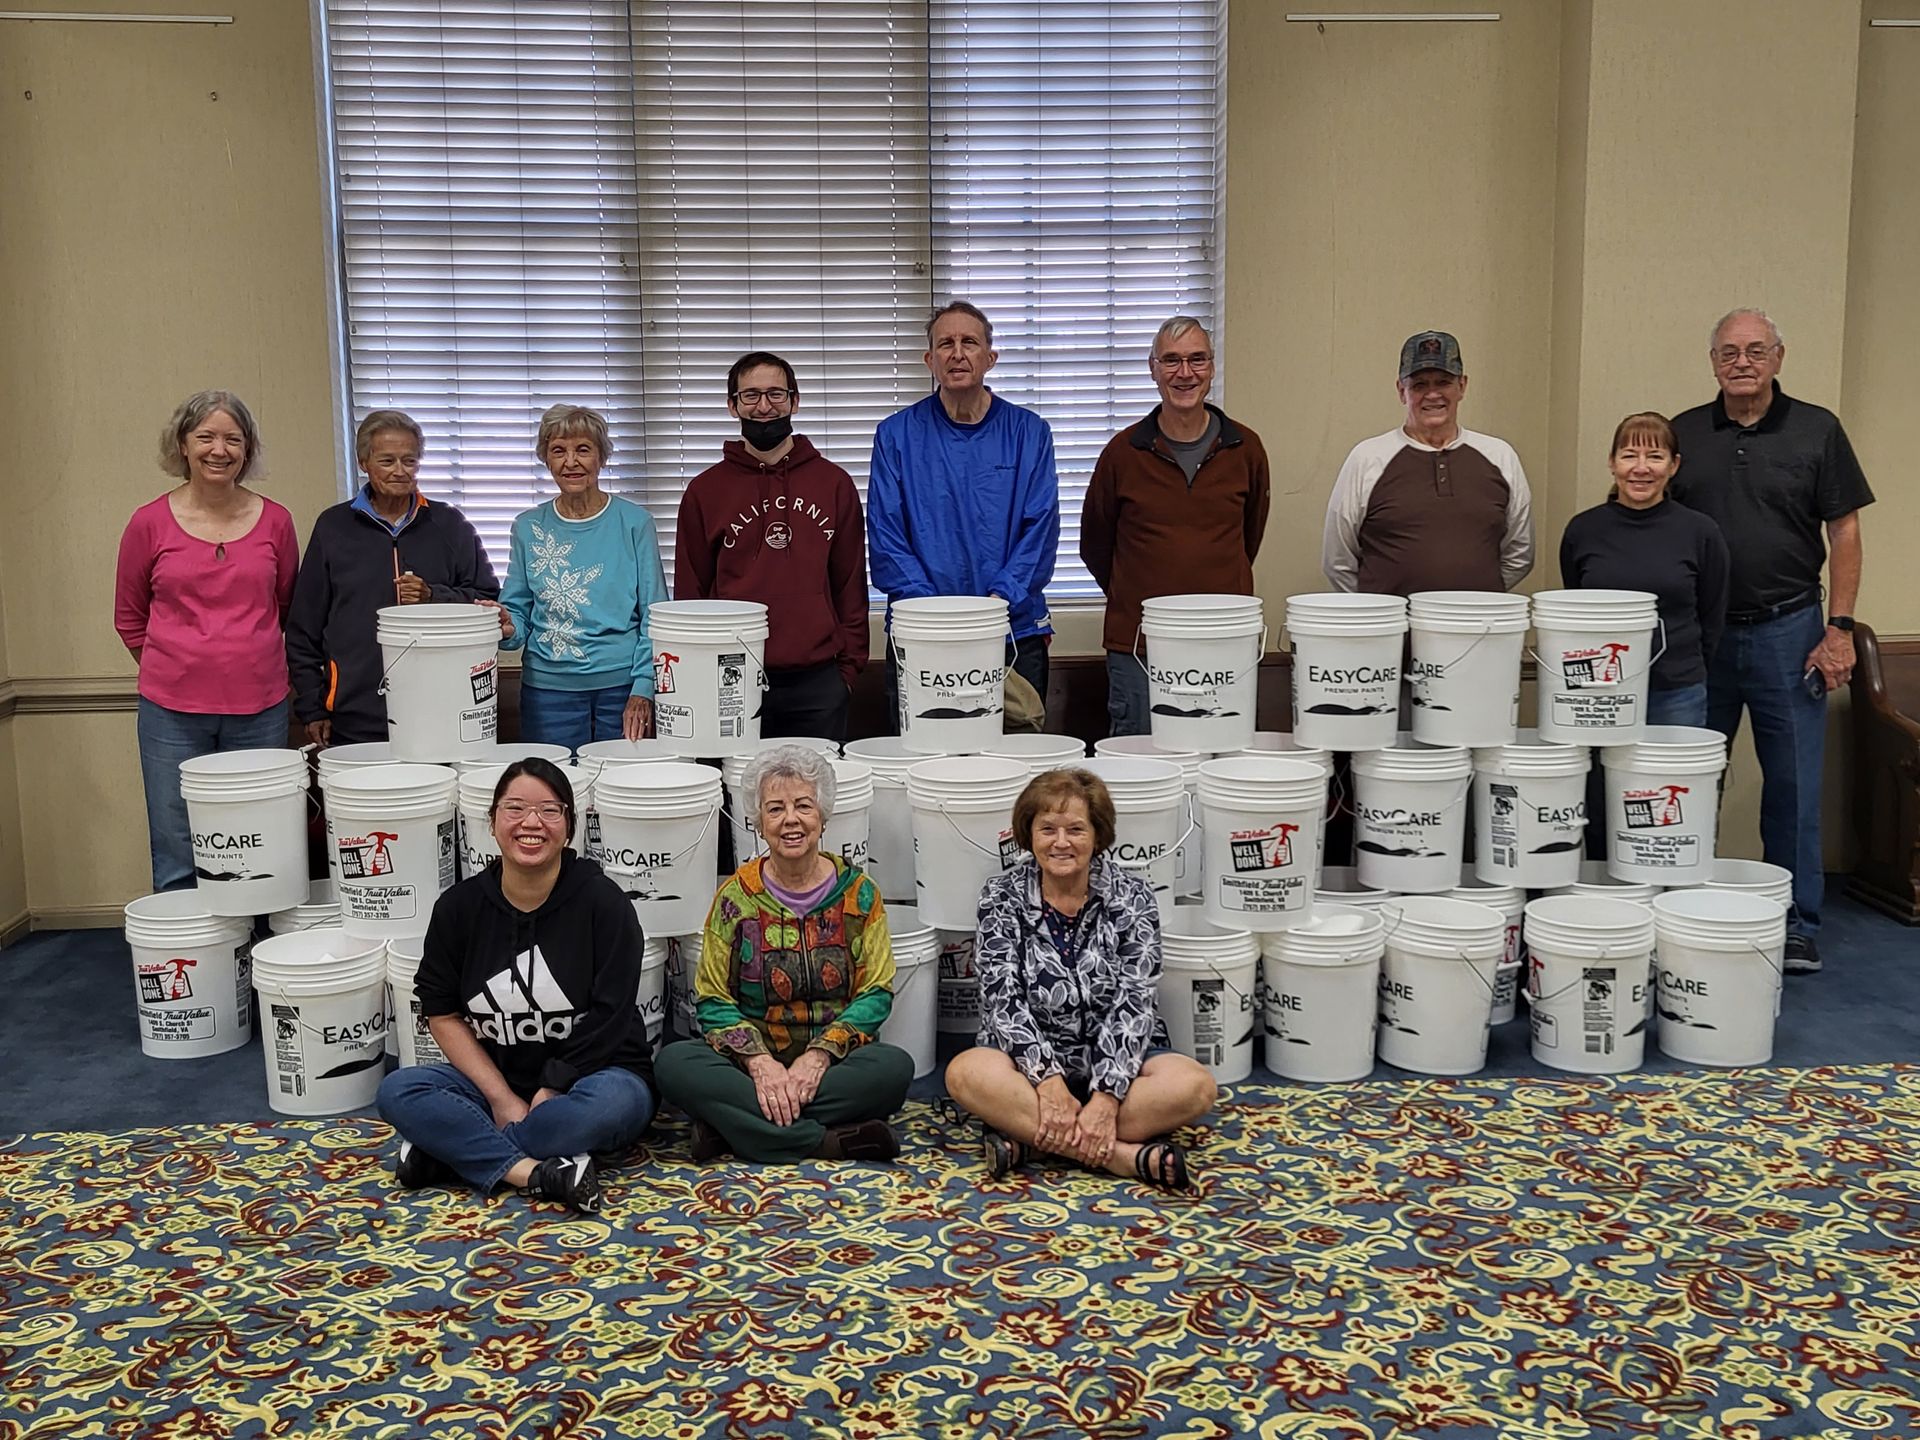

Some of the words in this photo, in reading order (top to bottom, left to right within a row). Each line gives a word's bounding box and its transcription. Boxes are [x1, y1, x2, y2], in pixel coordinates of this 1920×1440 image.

[1150, 665, 1235, 686] EASYCARE
[1309, 665, 1397, 684] EASYCARE
[1565, 662, 1591, 677] WELL
[473, 674, 491, 689] WELL
[920, 667, 1003, 688] EASYCARE
[475, 685, 492, 701] DONE
[1626, 803, 1650, 815] WELL
[338, 838, 348, 846] True
[346, 836, 368, 846] Value
[341, 851, 360, 863] WELL
[1233, 844, 1260, 857] WELL
[343, 863, 363, 875] DONE
[1236, 856, 1262, 869] DONE
[362, 887, 382, 898] True
[380, 886, 411, 898] Value
[140, 978, 159, 990] WELL
[143, 989, 162, 1001] DONE
[163, 1010, 182, 1021] True
[180, 1008, 211, 1020] Value
